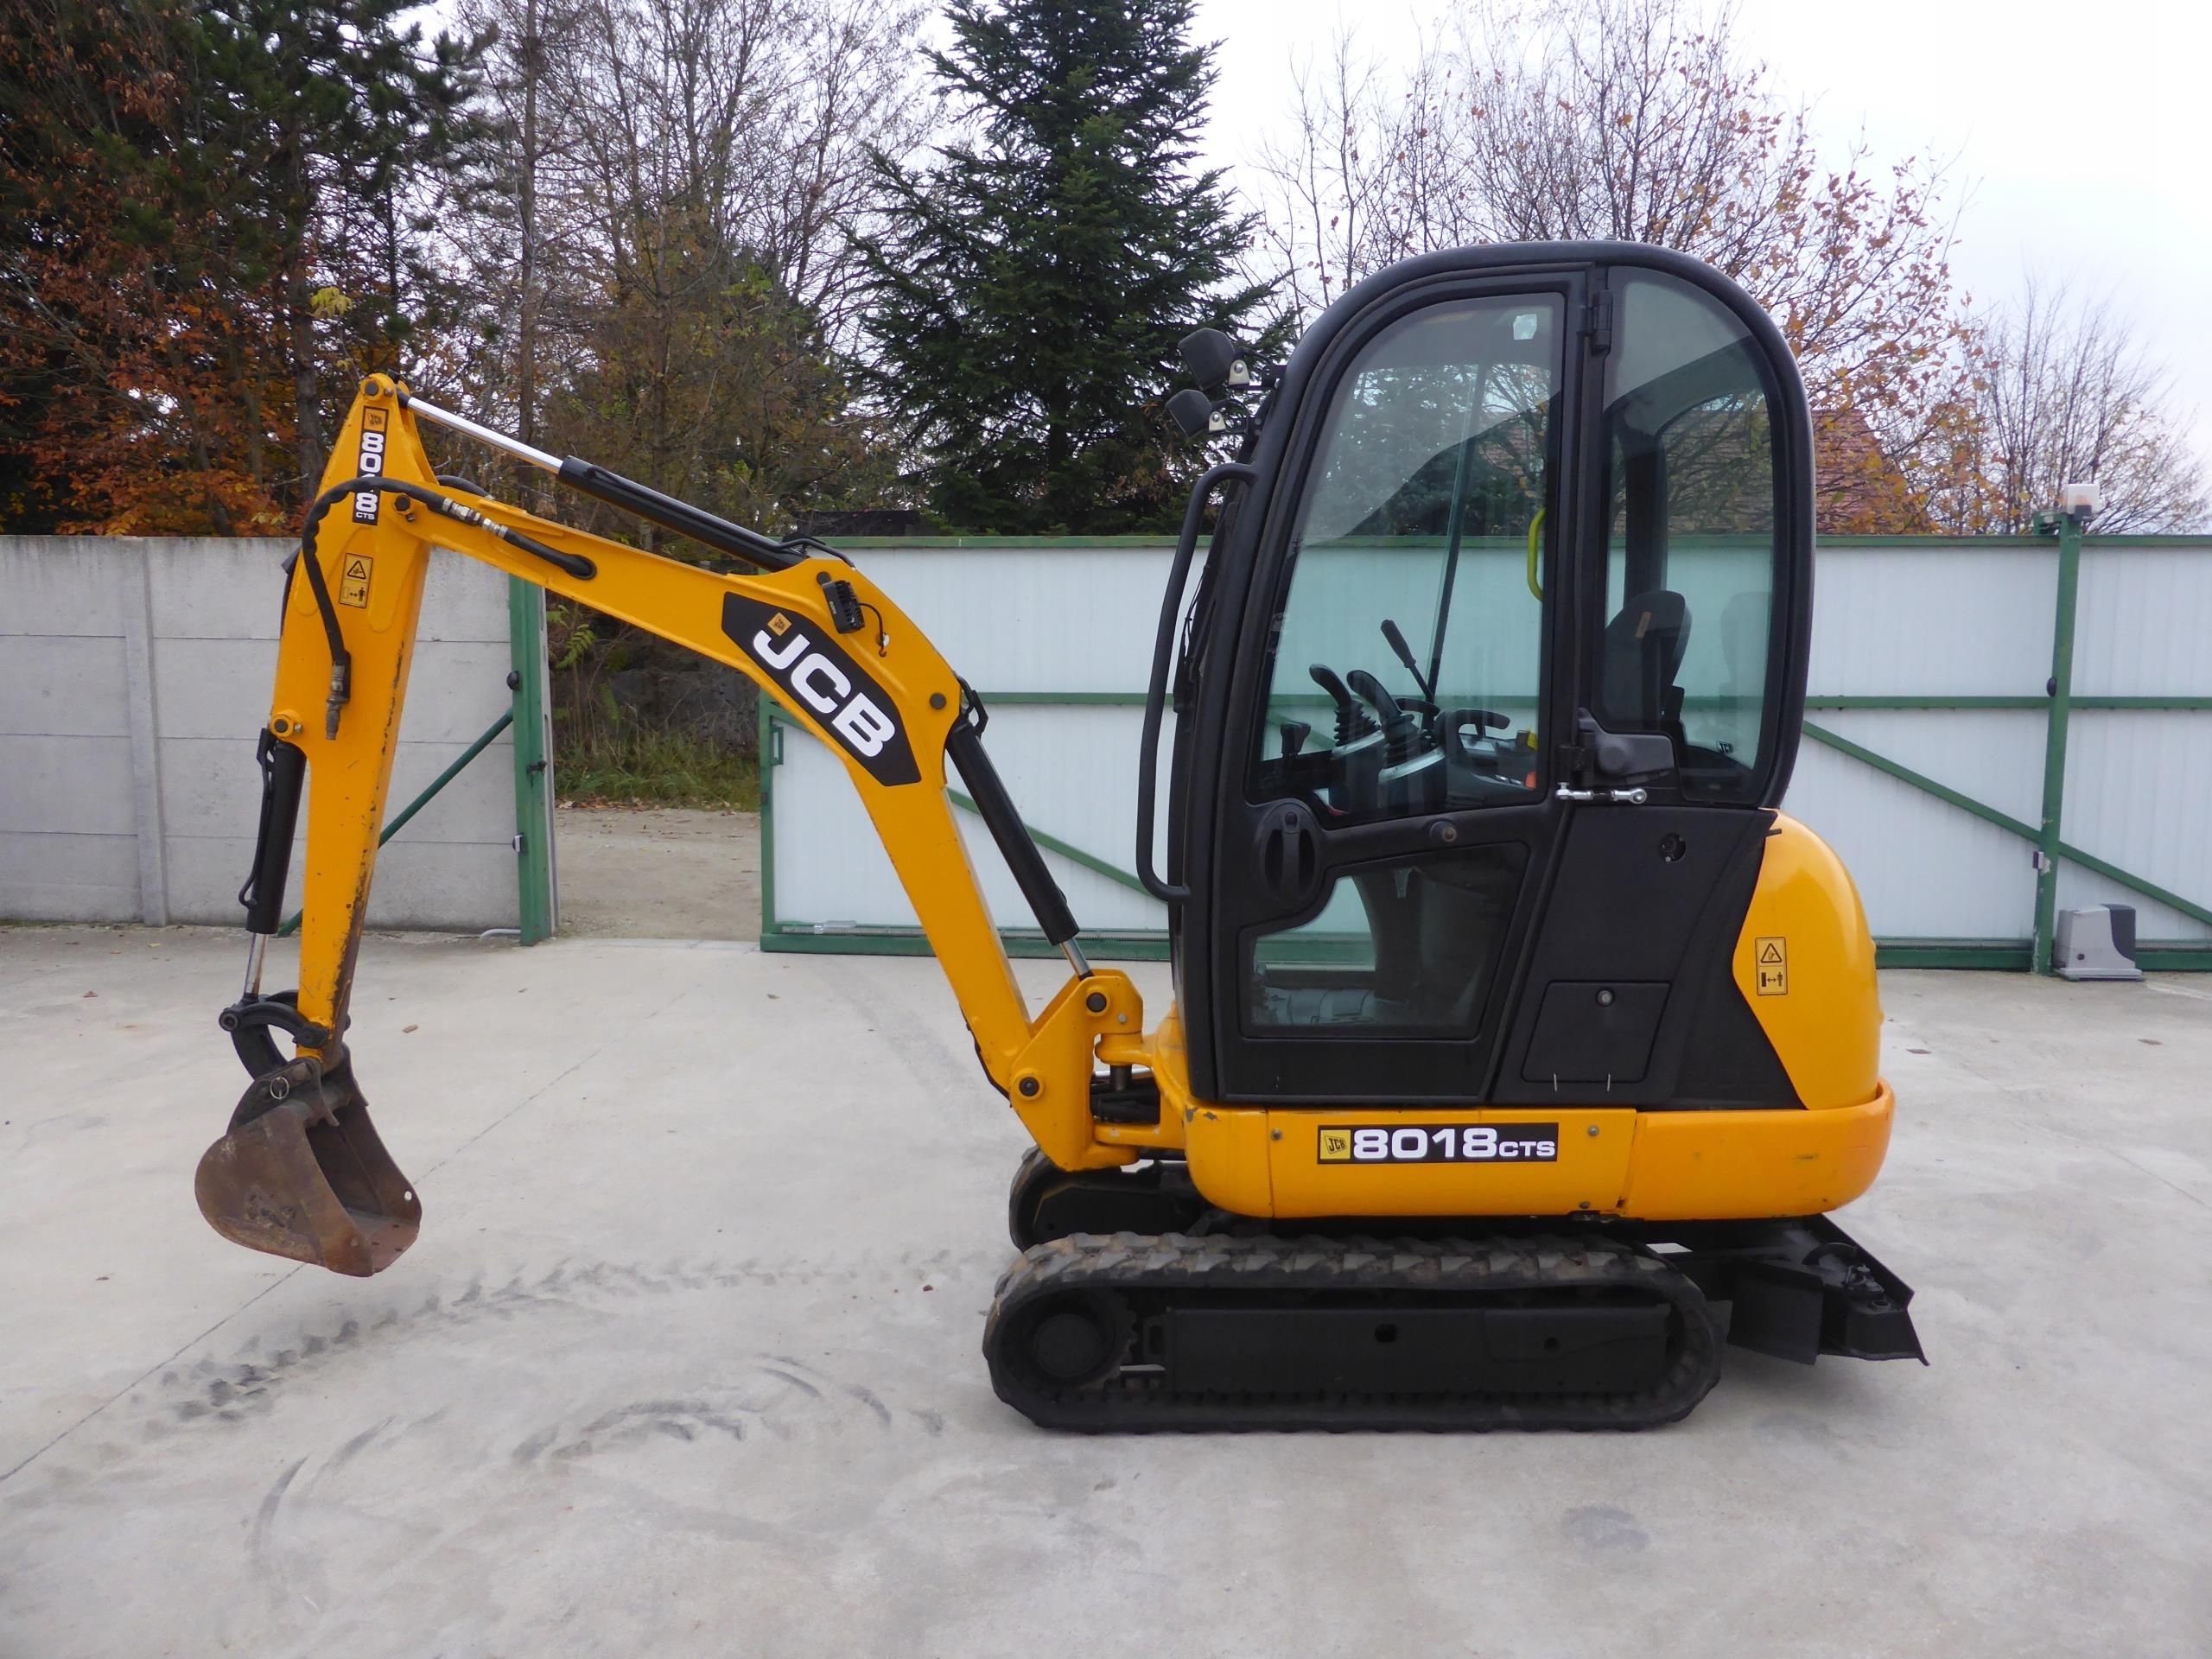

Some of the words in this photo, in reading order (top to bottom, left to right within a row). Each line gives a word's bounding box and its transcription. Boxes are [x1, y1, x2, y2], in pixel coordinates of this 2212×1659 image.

[356, 432, 384, 512] 808
[753, 630, 895, 757] JCB
[1328, 1136, 1345, 1151] JCB
